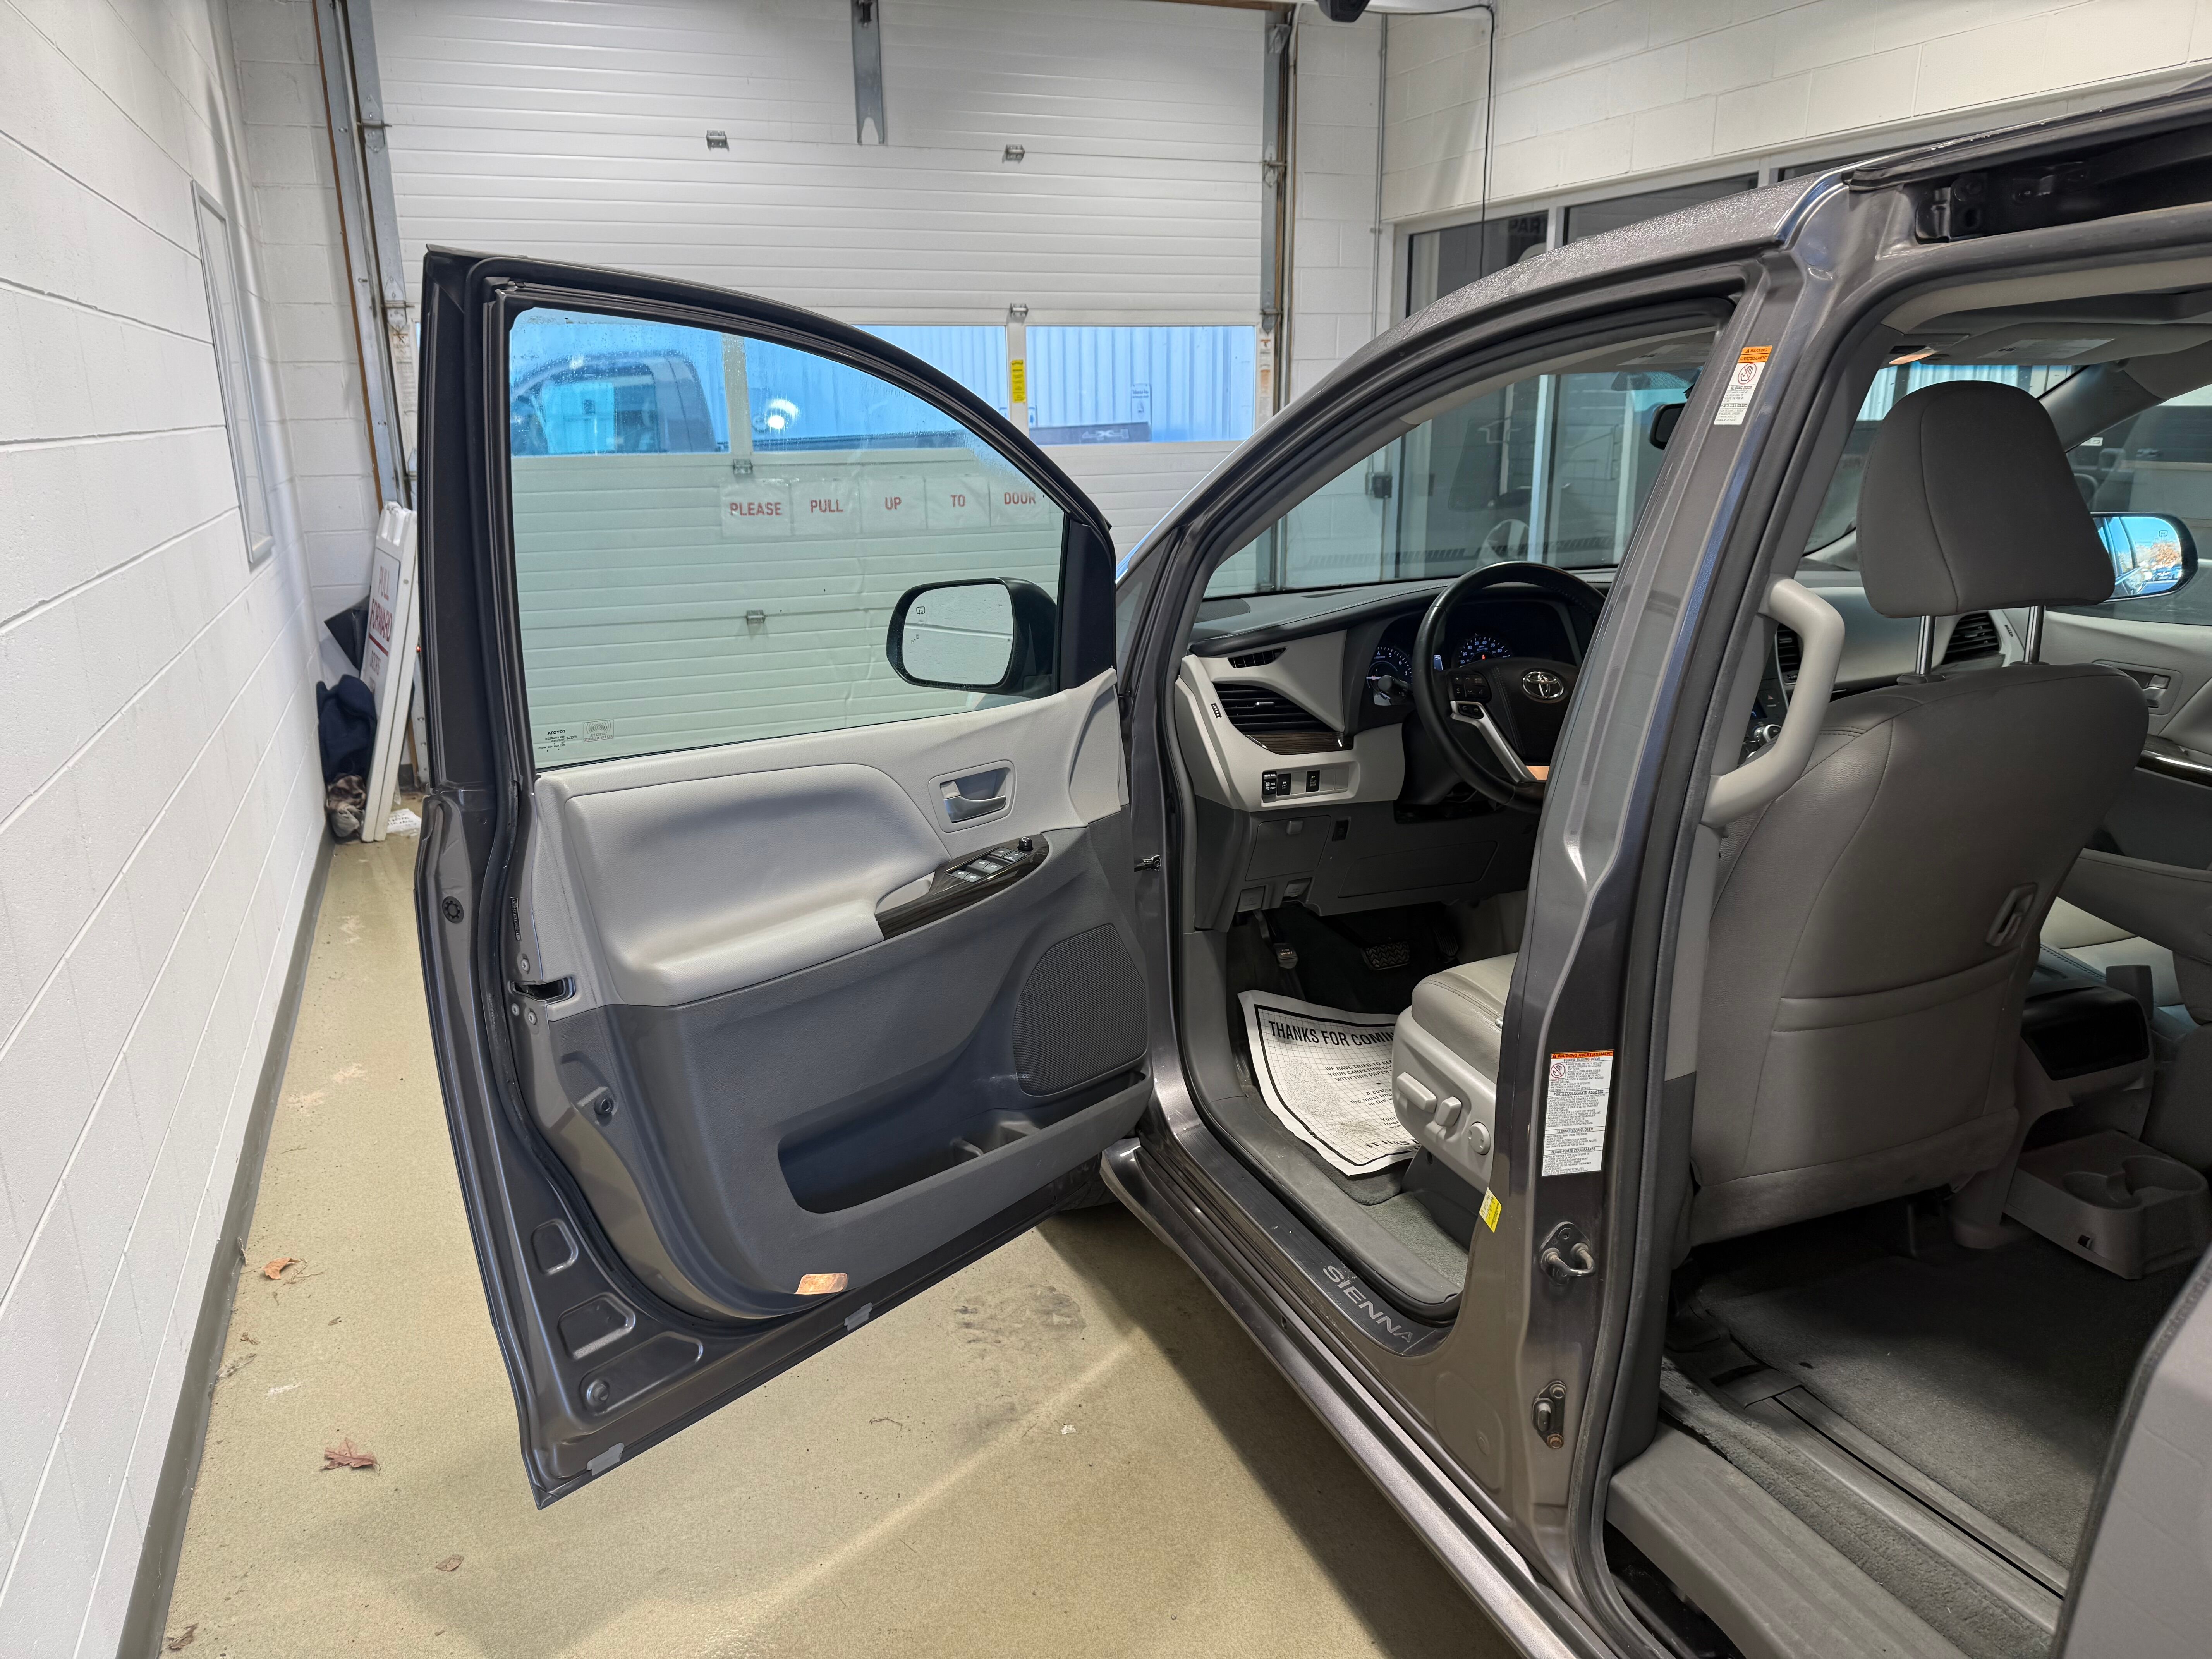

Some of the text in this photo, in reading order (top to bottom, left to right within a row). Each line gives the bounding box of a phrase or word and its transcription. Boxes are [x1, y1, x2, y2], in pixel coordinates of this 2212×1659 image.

[730, 492, 1037, 516] PLEASE PULL UP TO DOOR
[1269, 1021, 1319, 1043] THANKS
[1321, 1030, 1350, 1046] FOR
[1323, 1266, 1413, 1343] SIENNA
